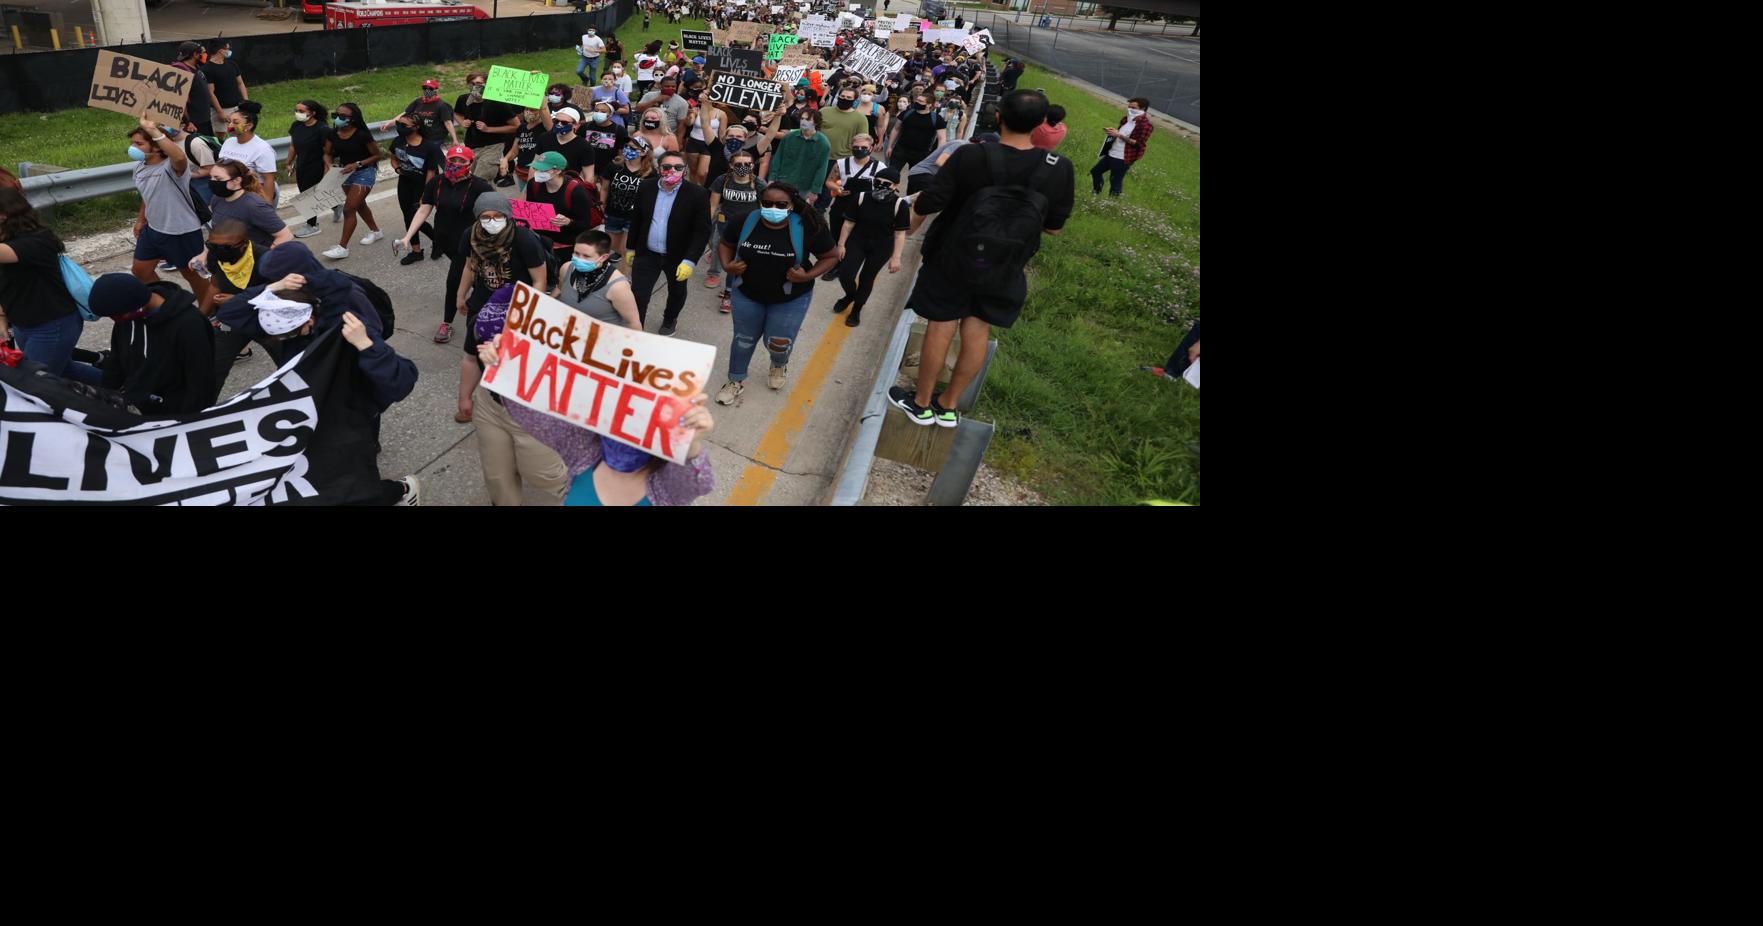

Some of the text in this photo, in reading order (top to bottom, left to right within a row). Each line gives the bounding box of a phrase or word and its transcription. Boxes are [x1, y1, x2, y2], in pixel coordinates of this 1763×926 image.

[707, 45, 733, 57] BLACK
[720, 56, 748, 69] LIVES
[110, 56, 189, 96] BLACK
[492, 67, 517, 79] BLACK
[717, 75, 782, 93] NO LONGER
[774, 69, 804, 82] RESIST
[91, 84, 137, 107] LIVES
[503, 79, 533, 92] MATTER
[147, 98, 183, 121] MATTER
[709, 84, 782, 112] SILENT
[505, 283, 697, 397] Black Lives
[483, 330, 687, 459] MATTER
[0, 409, 315, 491] LIVES
